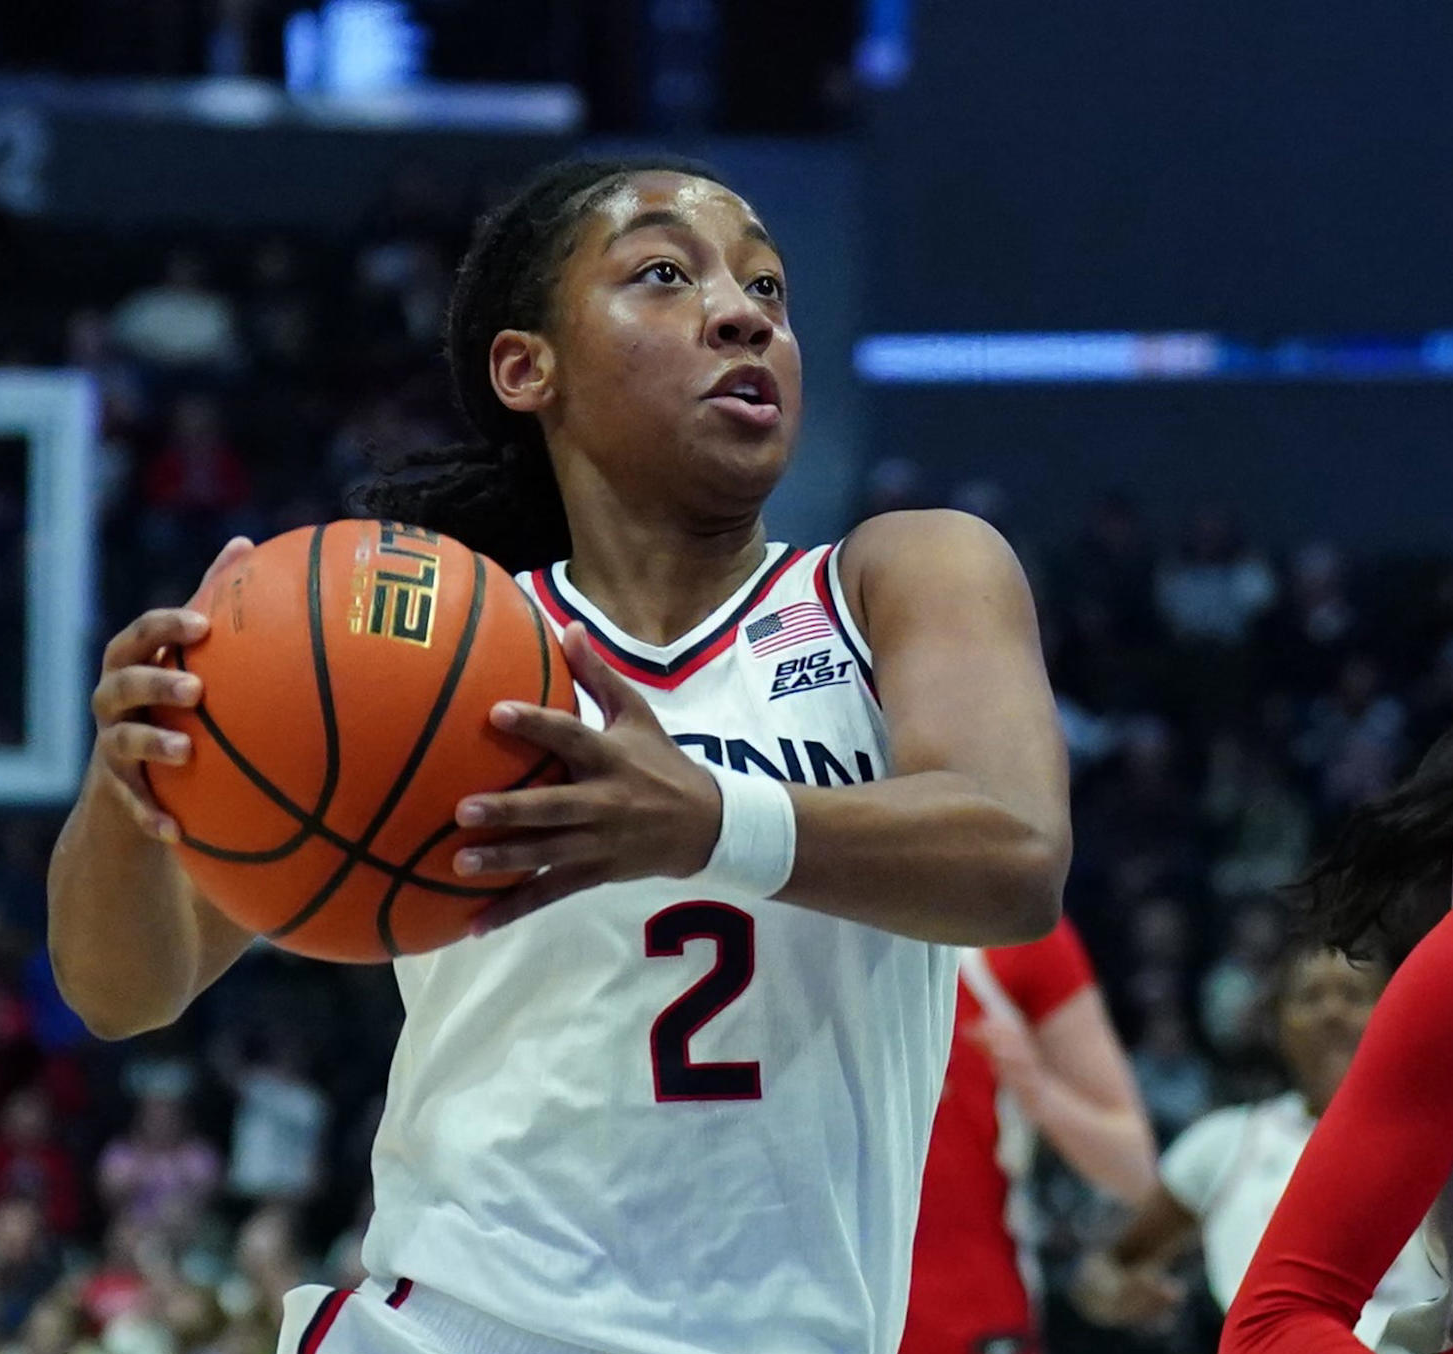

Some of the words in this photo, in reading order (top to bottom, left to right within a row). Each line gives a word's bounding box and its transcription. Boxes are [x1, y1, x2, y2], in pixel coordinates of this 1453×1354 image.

[770, 660, 853, 693] EAST
[775, 649, 832, 678] BIG
[644, 899, 762, 1103] 2
